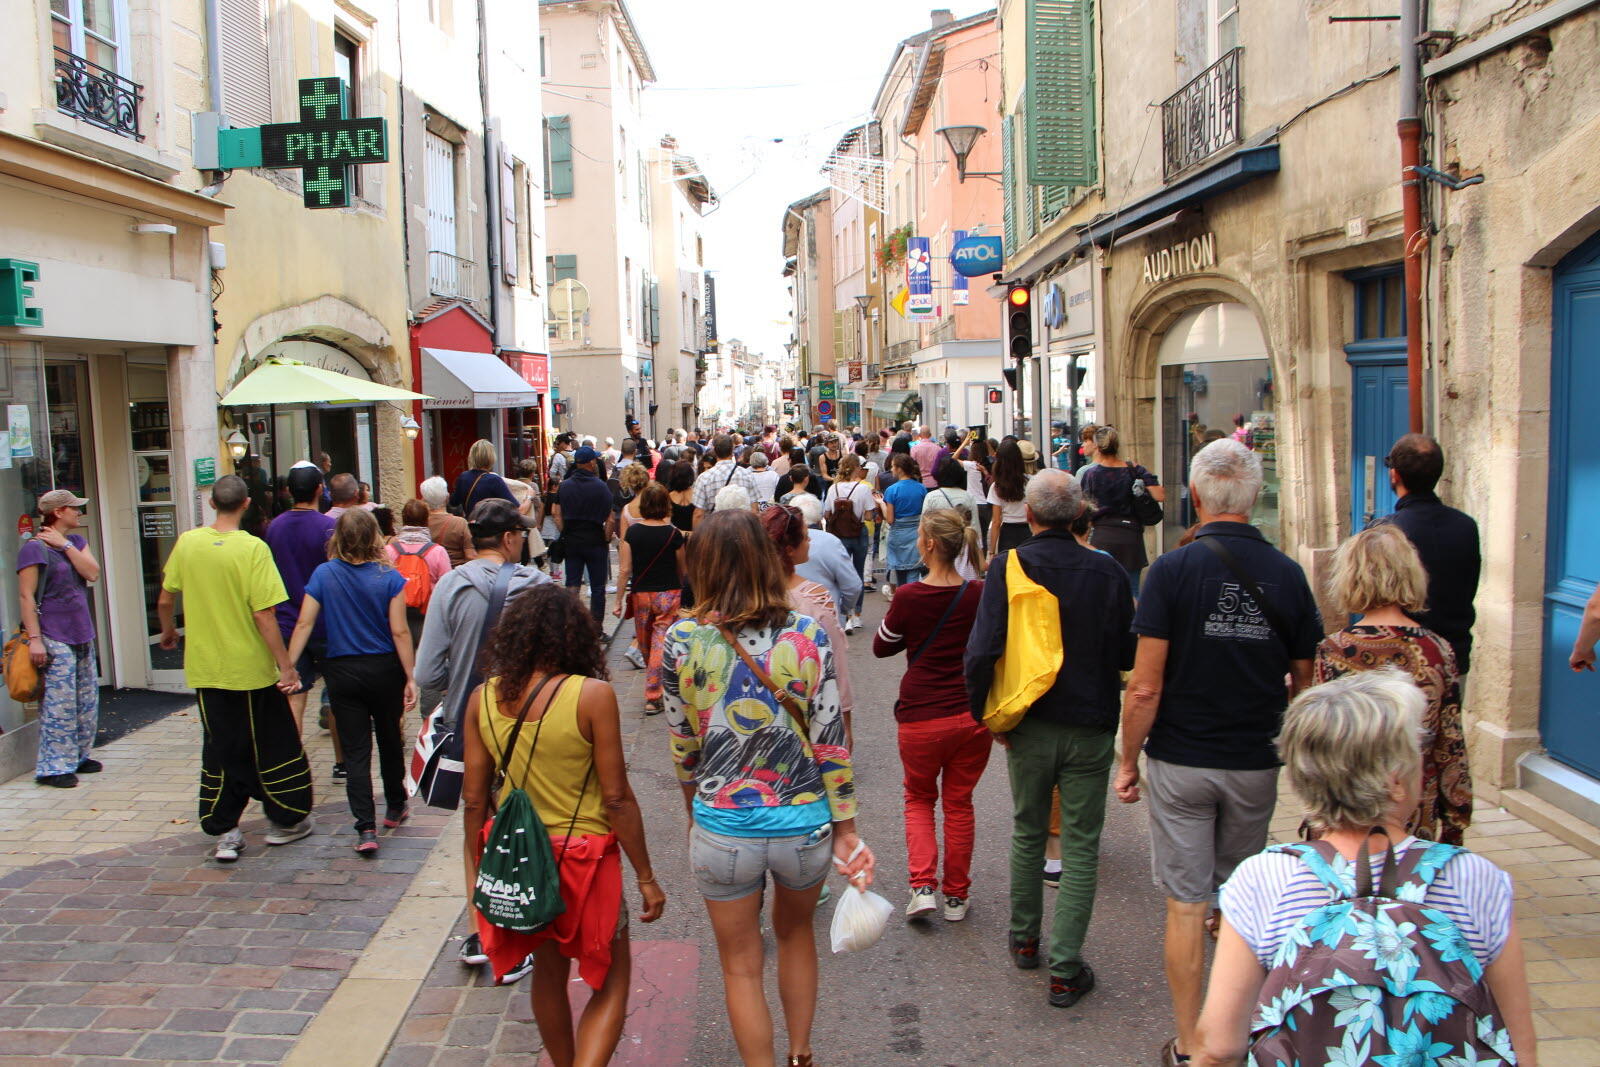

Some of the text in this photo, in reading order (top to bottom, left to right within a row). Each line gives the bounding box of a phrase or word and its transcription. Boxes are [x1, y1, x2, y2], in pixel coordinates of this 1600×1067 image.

[286, 129, 383, 160] PHAR
[955, 244, 999, 260] ATOL
[1143, 232, 1216, 284] AUDITION
